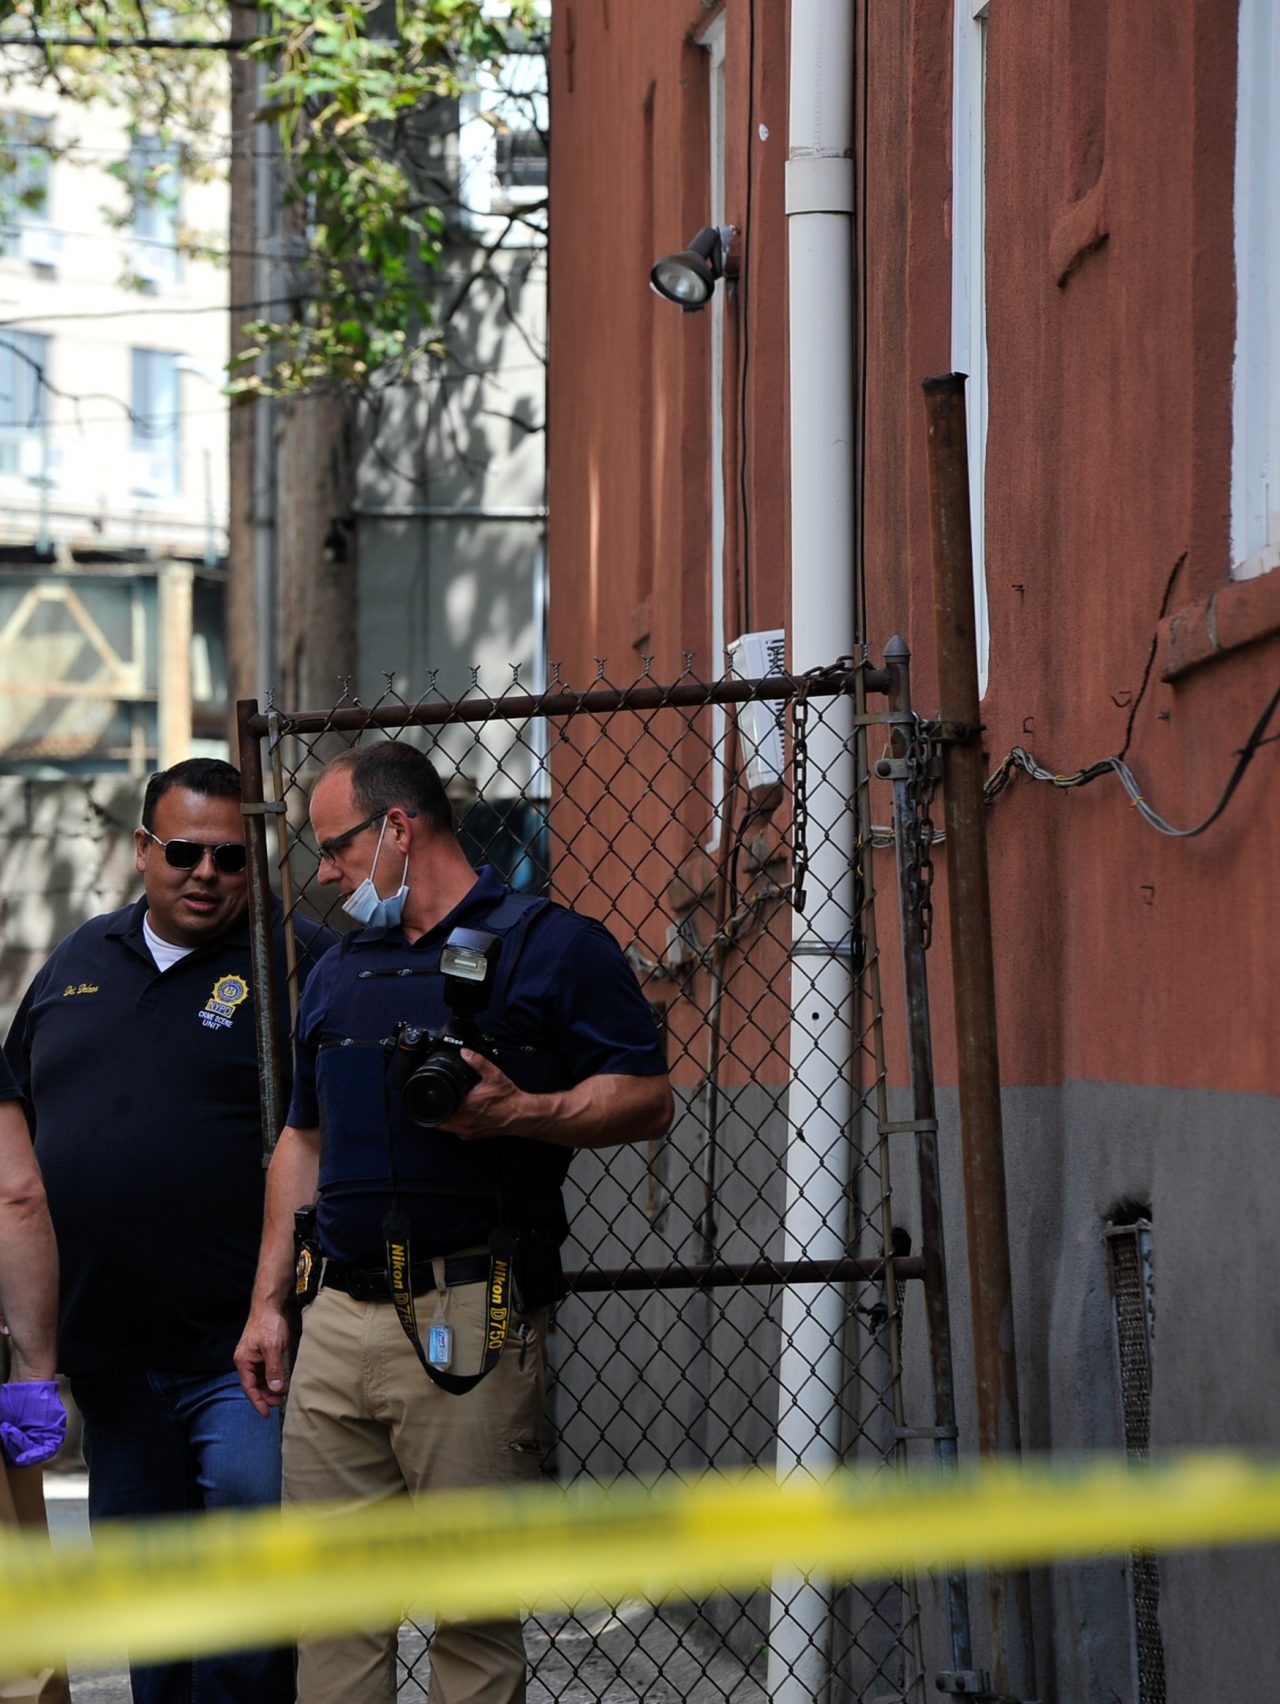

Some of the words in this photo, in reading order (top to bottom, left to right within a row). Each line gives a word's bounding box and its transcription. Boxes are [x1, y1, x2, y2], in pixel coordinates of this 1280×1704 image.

[207, 1001, 232, 1017] NYPD
[202, 1019, 221, 1030] UNIT
[443, 1035, 464, 1046] Nikon
[391, 1244, 405, 1289] Nikon
[491, 1260, 508, 1304] Nikon
[488, 1307, 507, 1349] D750
